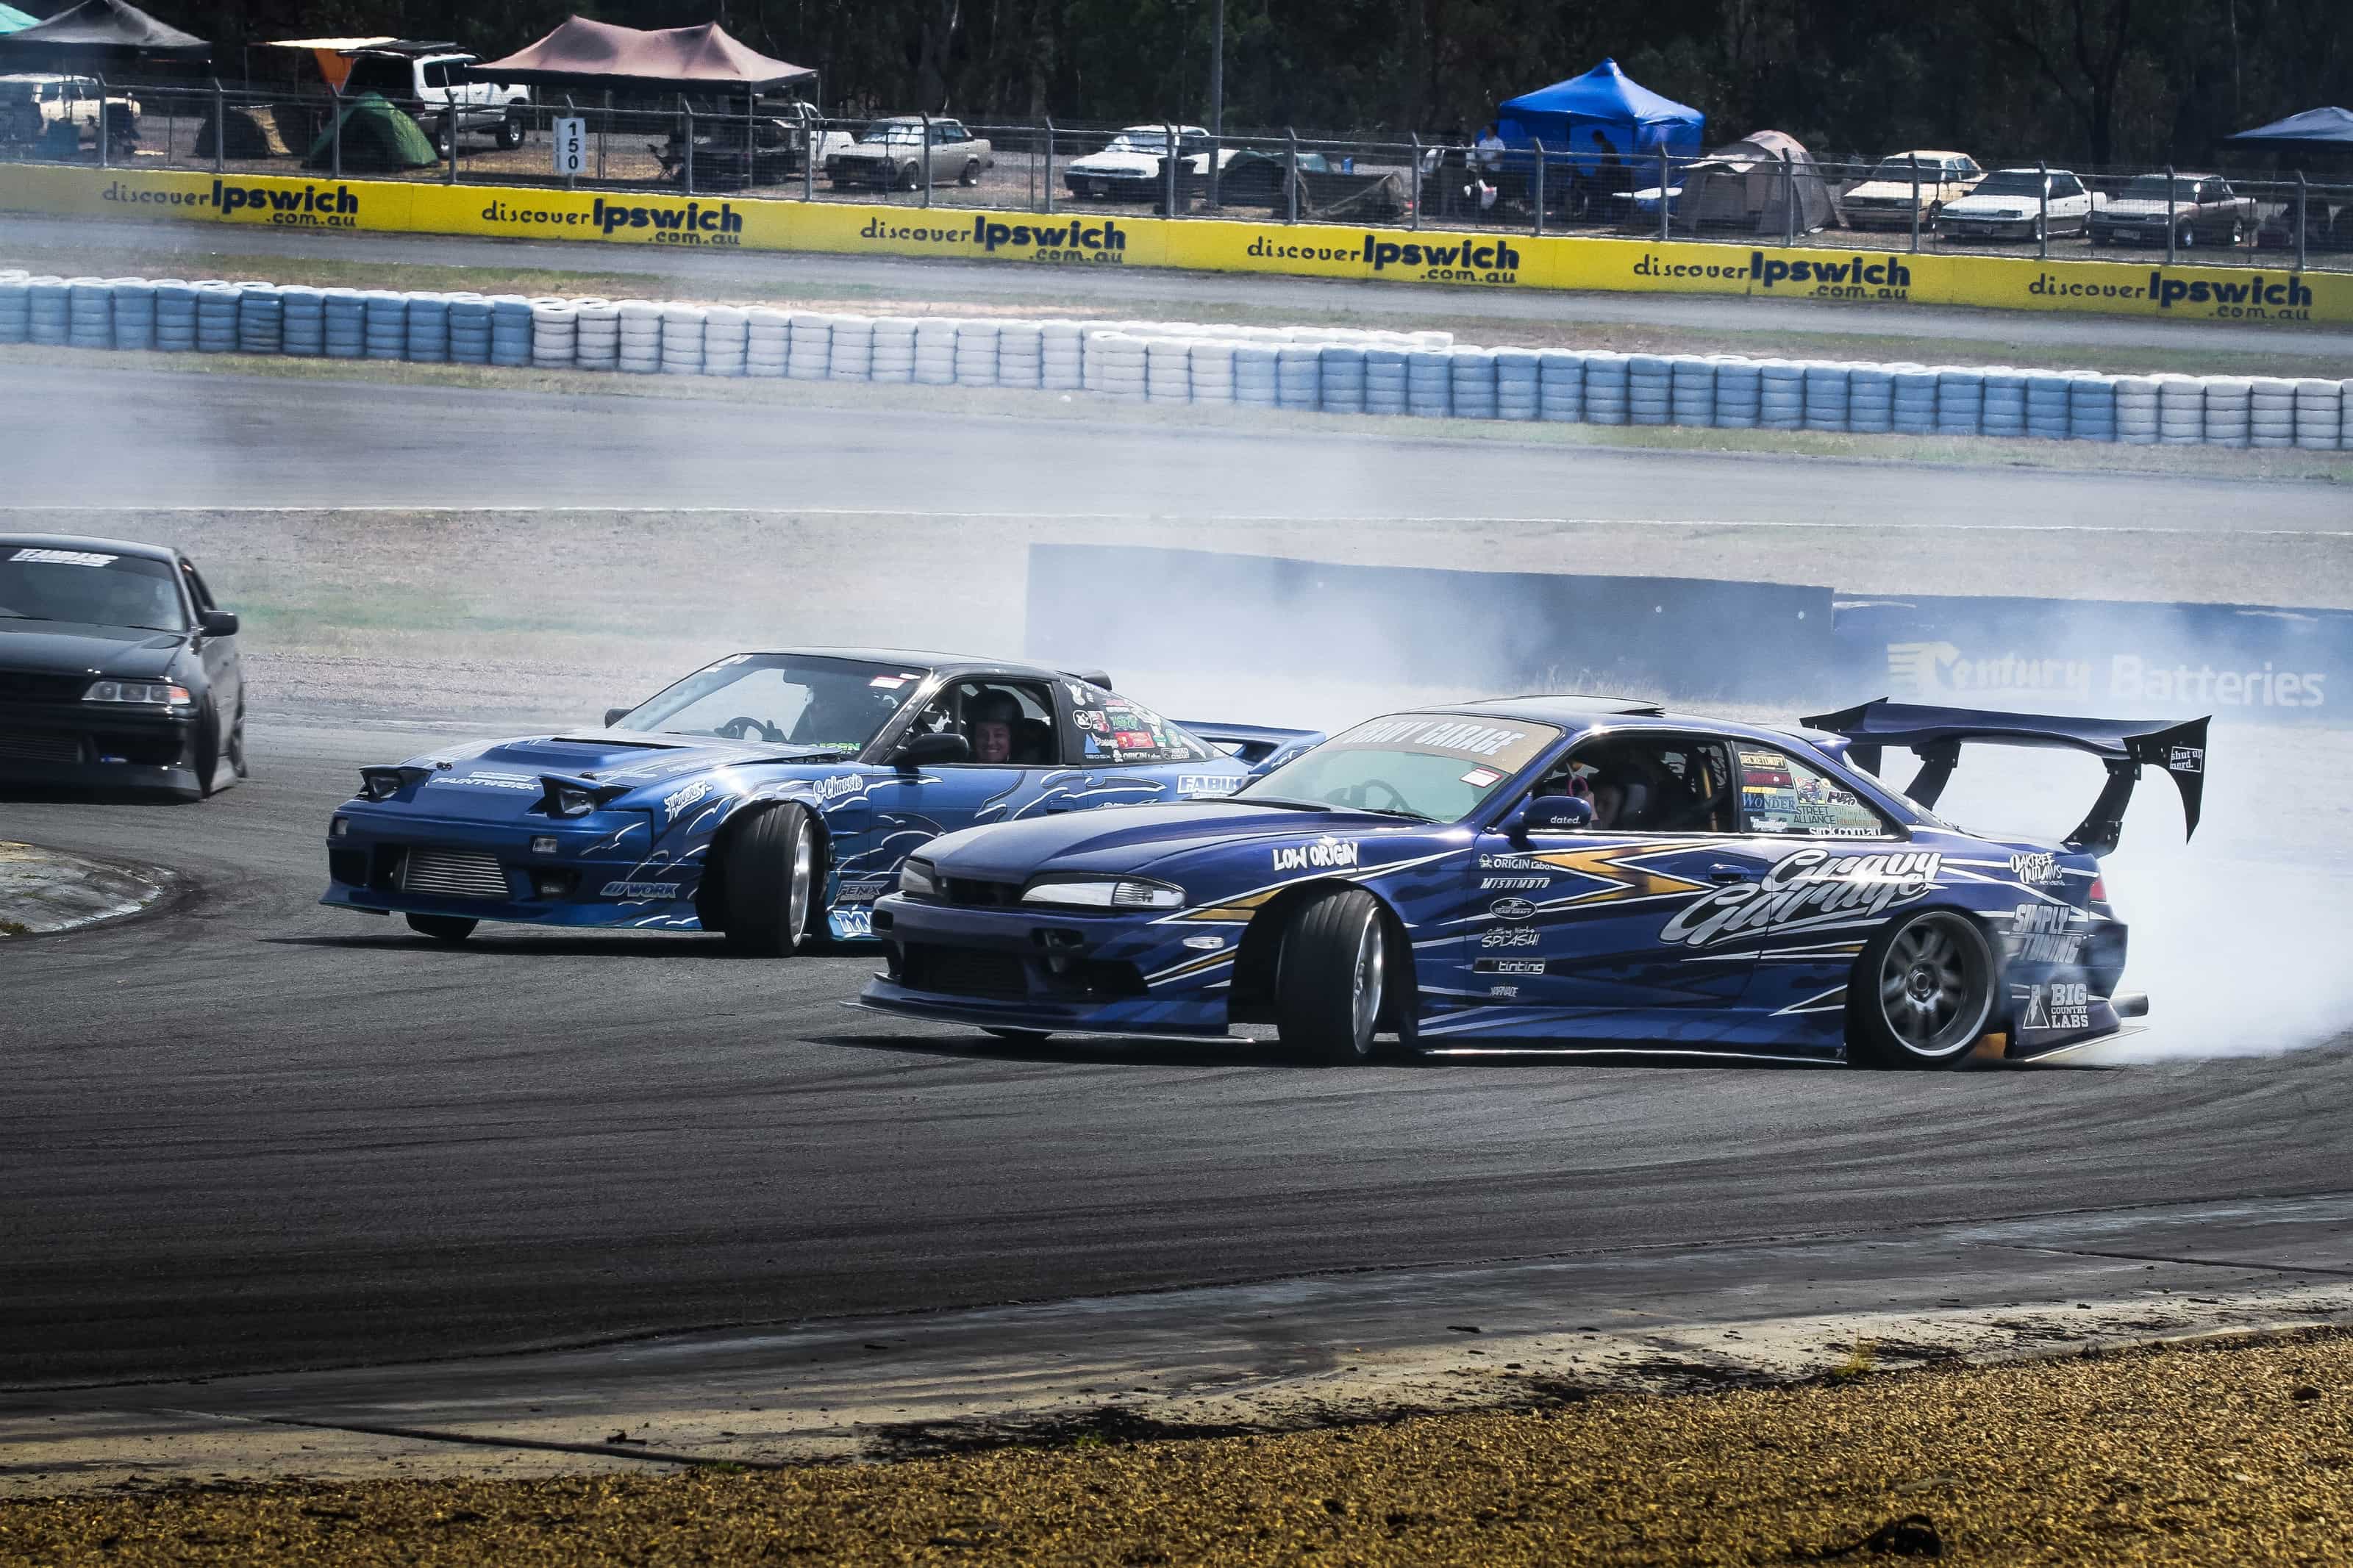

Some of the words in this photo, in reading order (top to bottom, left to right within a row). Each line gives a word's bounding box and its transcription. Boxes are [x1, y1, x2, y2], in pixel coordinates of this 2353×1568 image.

[266, 212, 357, 227] .com.au
[649, 231, 741, 246] .com.au
[1029, 248, 1124, 264] .com.au
[1420, 268, 1517, 284] .com.au
[1808, 284, 1908, 301] .com.au
[2208, 305, 2311, 321] .com.au
[2108, 654, 2327, 707] Batteries
[1414, 722, 1527, 755] GARAGE
[2171, 750, 2190, 760] shut
[1796, 806, 1829, 816] STREET
[1550, 815, 1581, 824] dated.
[1794, 815, 1837, 824] ALLIANCE
[1272, 846, 1308, 871] LOW
[1310, 841, 1359, 867] ORIGIN
[1493, 859, 1530, 869] ORIGIN
[1760, 848, 1943, 892] Gravy
[2019, 864, 2062, 884] OUTLAWS
[1659, 873, 1932, 948] Garage
[2012, 903, 2071, 934] SIMPLY
[2018, 934, 2082, 964] TUNING
[1499, 961, 1545, 973] tinting
[2051, 983, 2088, 1006] BIG
[2051, 1006, 2088, 1014] COUNTRY
[2051, 1014, 2089, 1028] LABS
